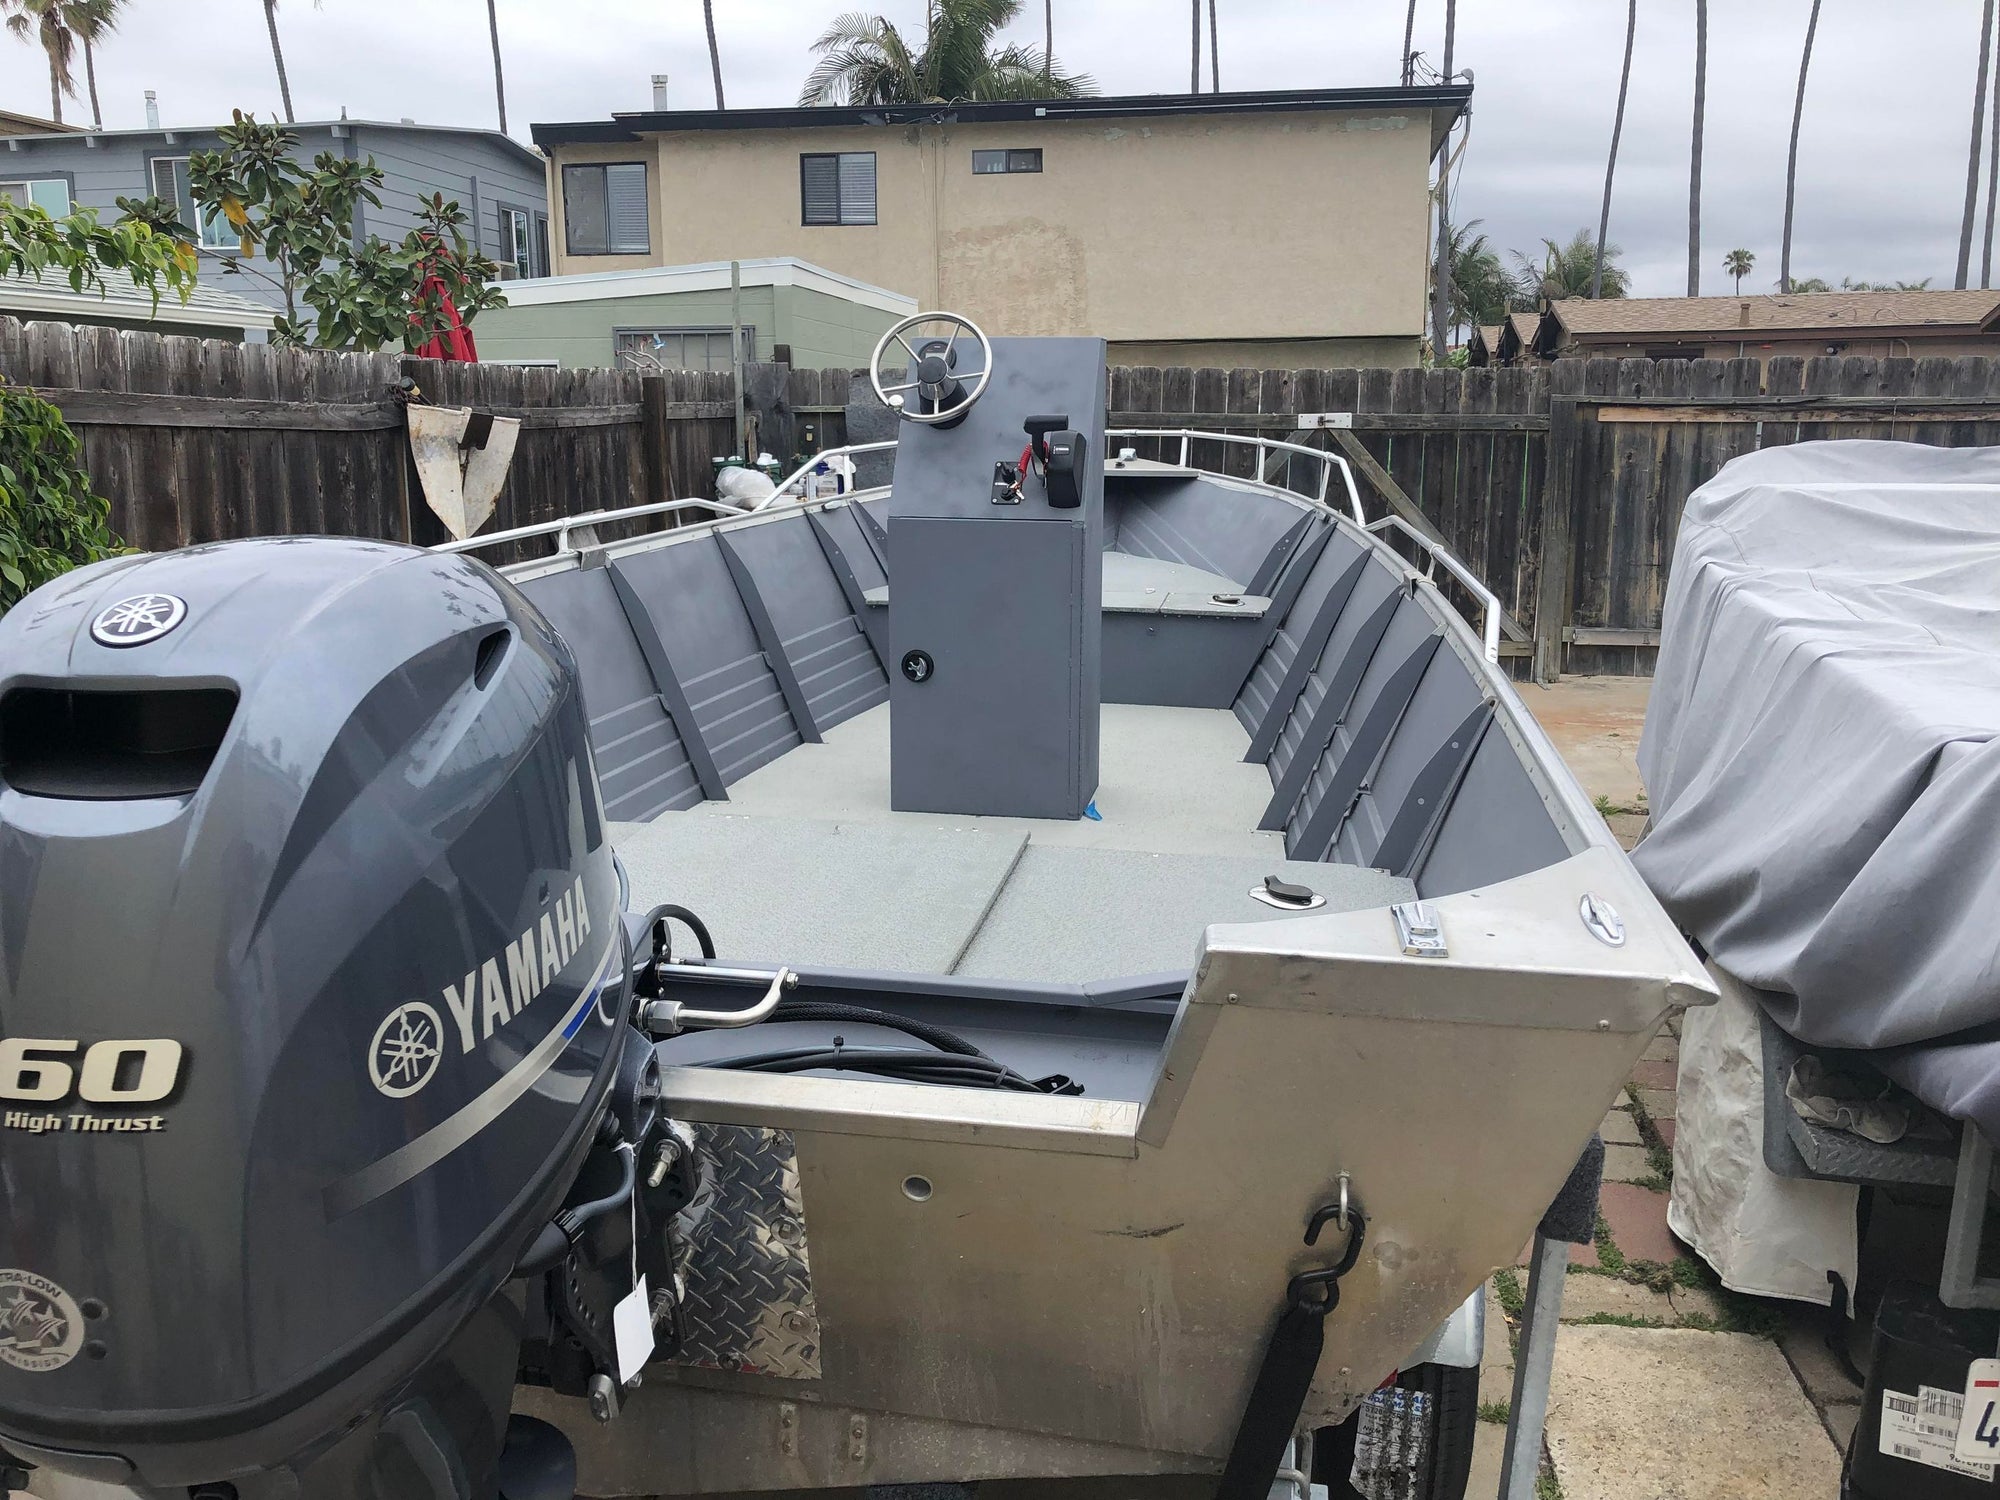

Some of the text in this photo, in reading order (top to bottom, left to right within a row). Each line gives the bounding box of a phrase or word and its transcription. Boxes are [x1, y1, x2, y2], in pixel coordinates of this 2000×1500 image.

[442, 874, 591, 1055] YAMAHA
[0, 1037, 183, 1103] 60
[4, 1111, 165, 1133] High Thrust
[1975, 1401, 1999, 1448] 4
